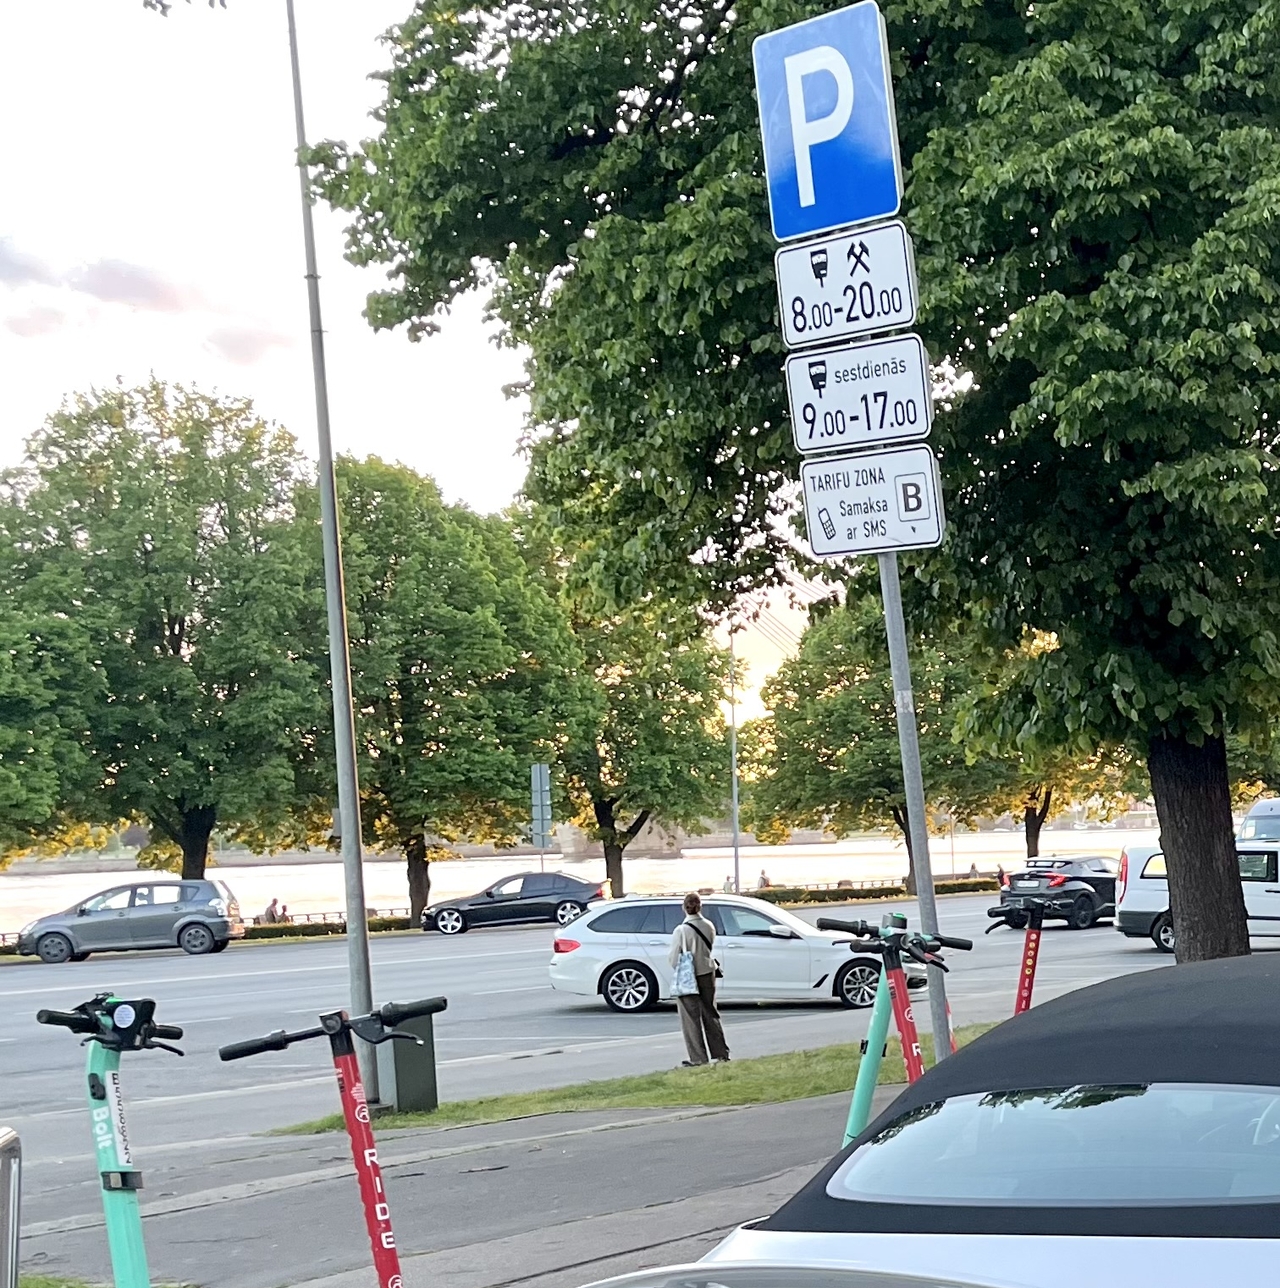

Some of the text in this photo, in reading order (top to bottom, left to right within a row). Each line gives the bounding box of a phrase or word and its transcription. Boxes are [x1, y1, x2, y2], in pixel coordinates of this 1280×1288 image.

[784, 45, 854, 208] P
[791, 281, 903, 333] 8.00-20.00
[834, 357, 907, 384] sestdienās
[810, 467, 886, 493] TARIFU ZONA
[839, 497, 888, 517] Samaksa
[901, 482, 923, 513] B
[846, 519, 887, 540] ar SMS
[93, 1106, 113, 1149] Bolt
[363, 1148, 396, 1249] RIDE
